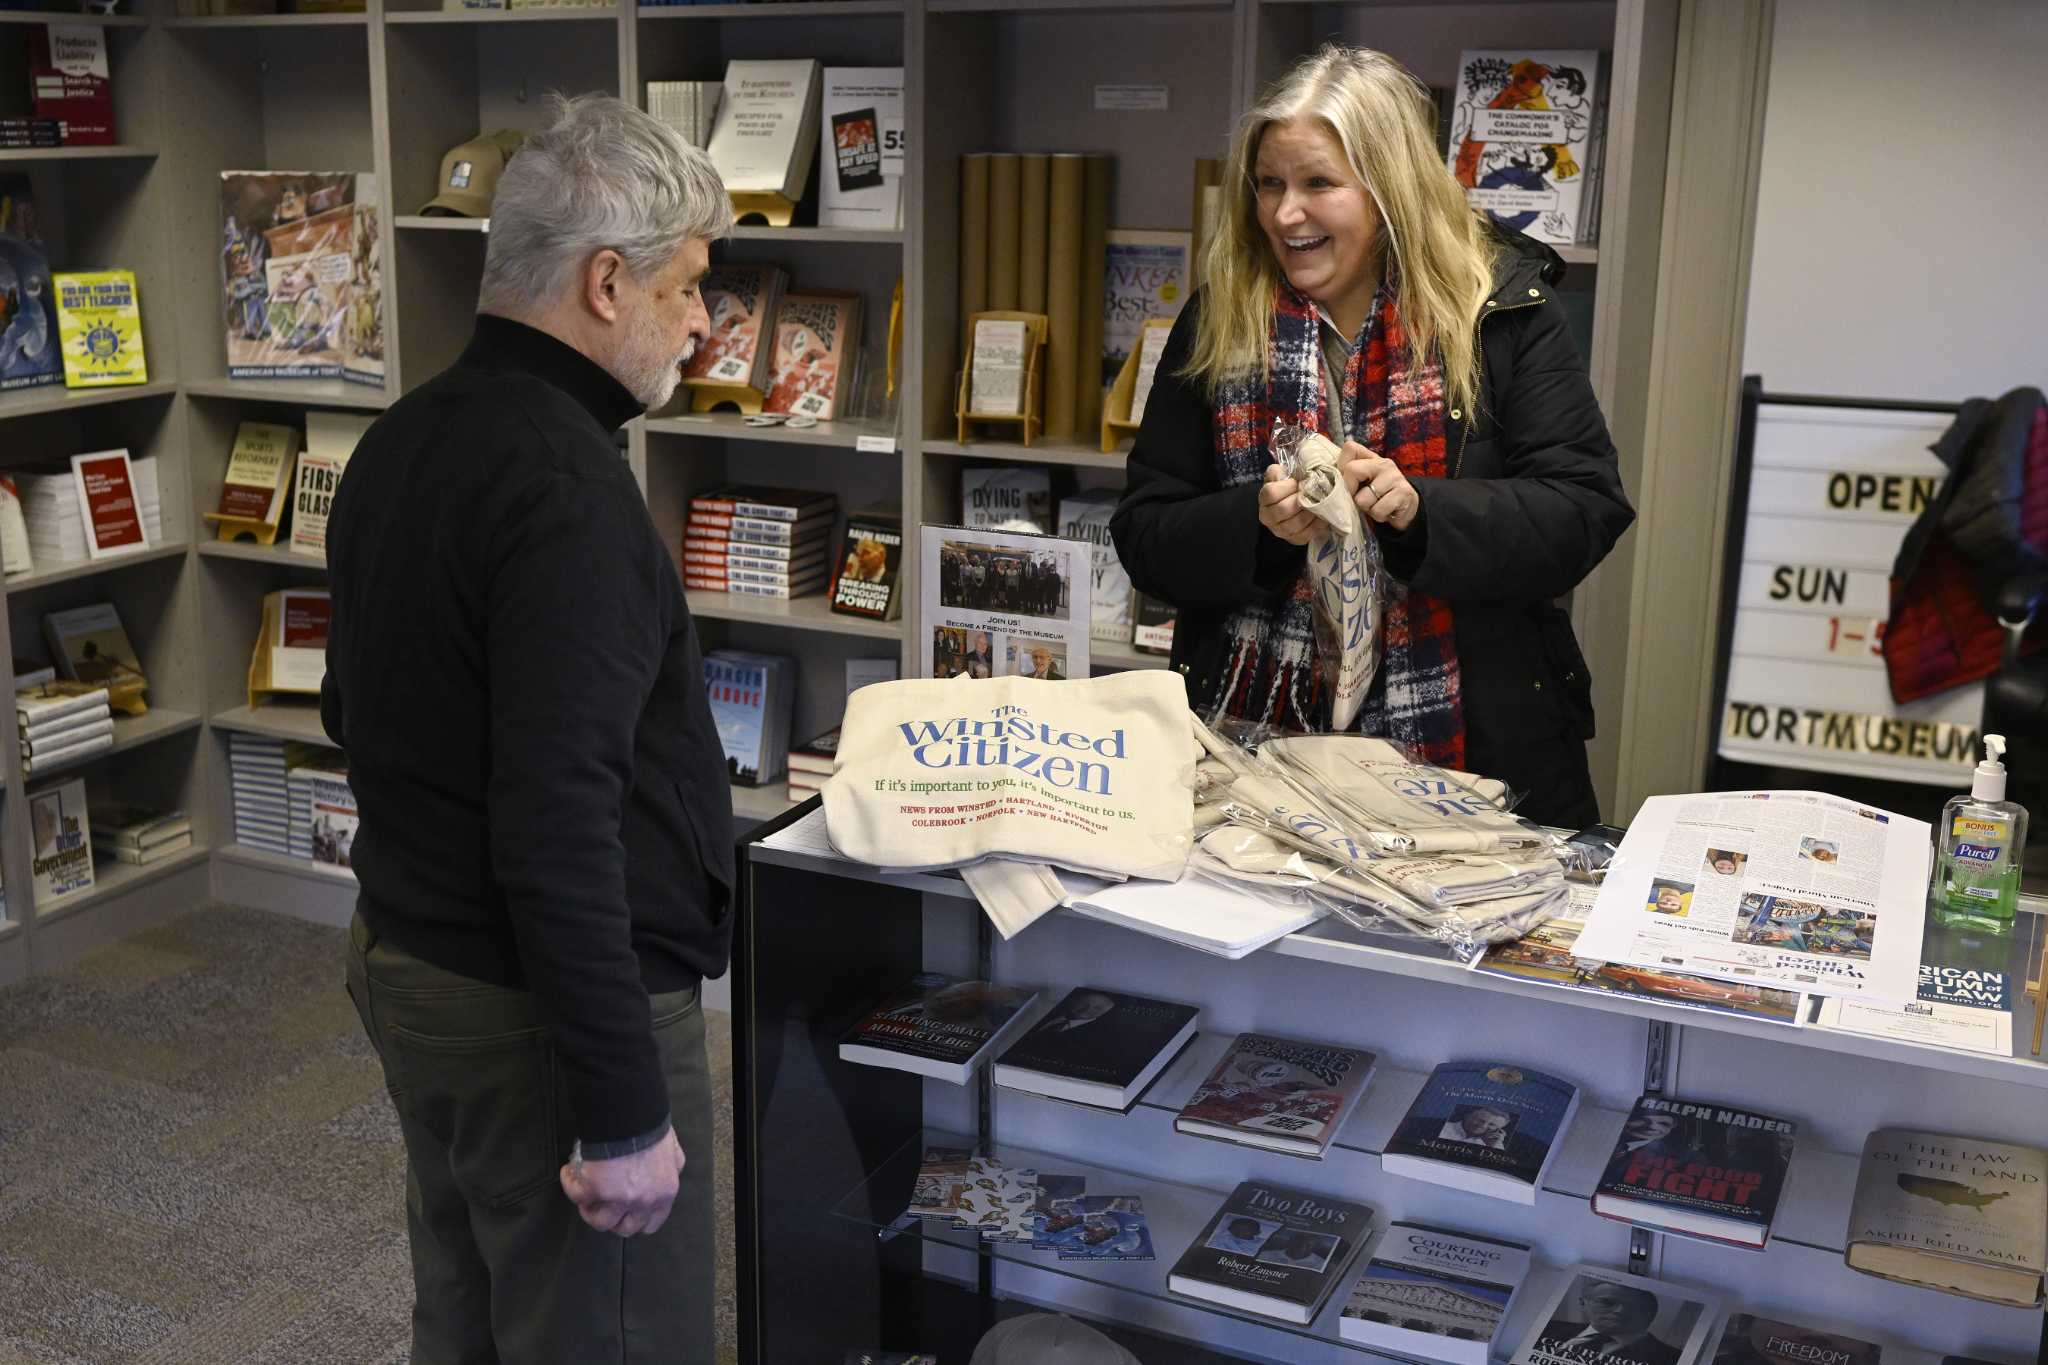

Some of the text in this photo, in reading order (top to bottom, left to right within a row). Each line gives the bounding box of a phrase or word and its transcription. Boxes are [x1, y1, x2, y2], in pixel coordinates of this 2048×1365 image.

[972, 487, 1021, 509] DYING
[1827, 473, 1936, 512] OPEN
[838, 578, 890, 593] BREAKING
[838, 586, 889, 601] THROUGH
[1769, 566, 1848, 605] SUN
[835, 594, 887, 612] POWER
[987, 616, 1006, 625] JOIN
[983, 624, 1008, 633] FRIEND
[1033, 631, 1064, 640] MUSEUM
[712, 687, 761, 708] ABOVE
[991, 705, 1028, 718] The
[913, 736, 1113, 796] Citizen
[875, 779, 886, 791] If
[889, 779, 906, 791] it's
[910, 779, 973, 796] important
[977, 781, 990, 791] to
[991, 778, 1017, 791] you,
[1020, 778, 1037, 793] it's
[1041, 787, 1100, 815] important
[1102, 806, 1115, 817] to
[900, 796, 1109, 832] NEWS FROM WINSTED HARTLAND RIVERTON
[911, 807, 1097, 836] COLEBROOK NORFOLK NEW HARTFORD
[1965, 822, 1995, 832] BONUS
[1959, 844, 1996, 860] Purell
[1936, 986, 2003, 1002] LAW
[869, 1023, 928, 1040] MAKING
[944, 1036, 972, 1048] BIG
[1641, 1098, 1793, 1134] RALPH NADER
[1416, 1138, 1473, 1155] Morris
[1904, 1142, 2012, 1164] THE LAW
[1916, 1159, 1961, 1173] THE
[1971, 1167, 2040, 1184] LAND
[1623, 1163, 1761, 1205] FIGHT
[1247, 1187, 1291, 1213] Two
[1295, 1200, 1350, 1225] Boys
[1864, 1229, 2029, 1263] AKHIL REED AMAR
[1217, 1255, 1250, 1272] Robert
[1764, 1335, 1850, 1365] FREEDOM
